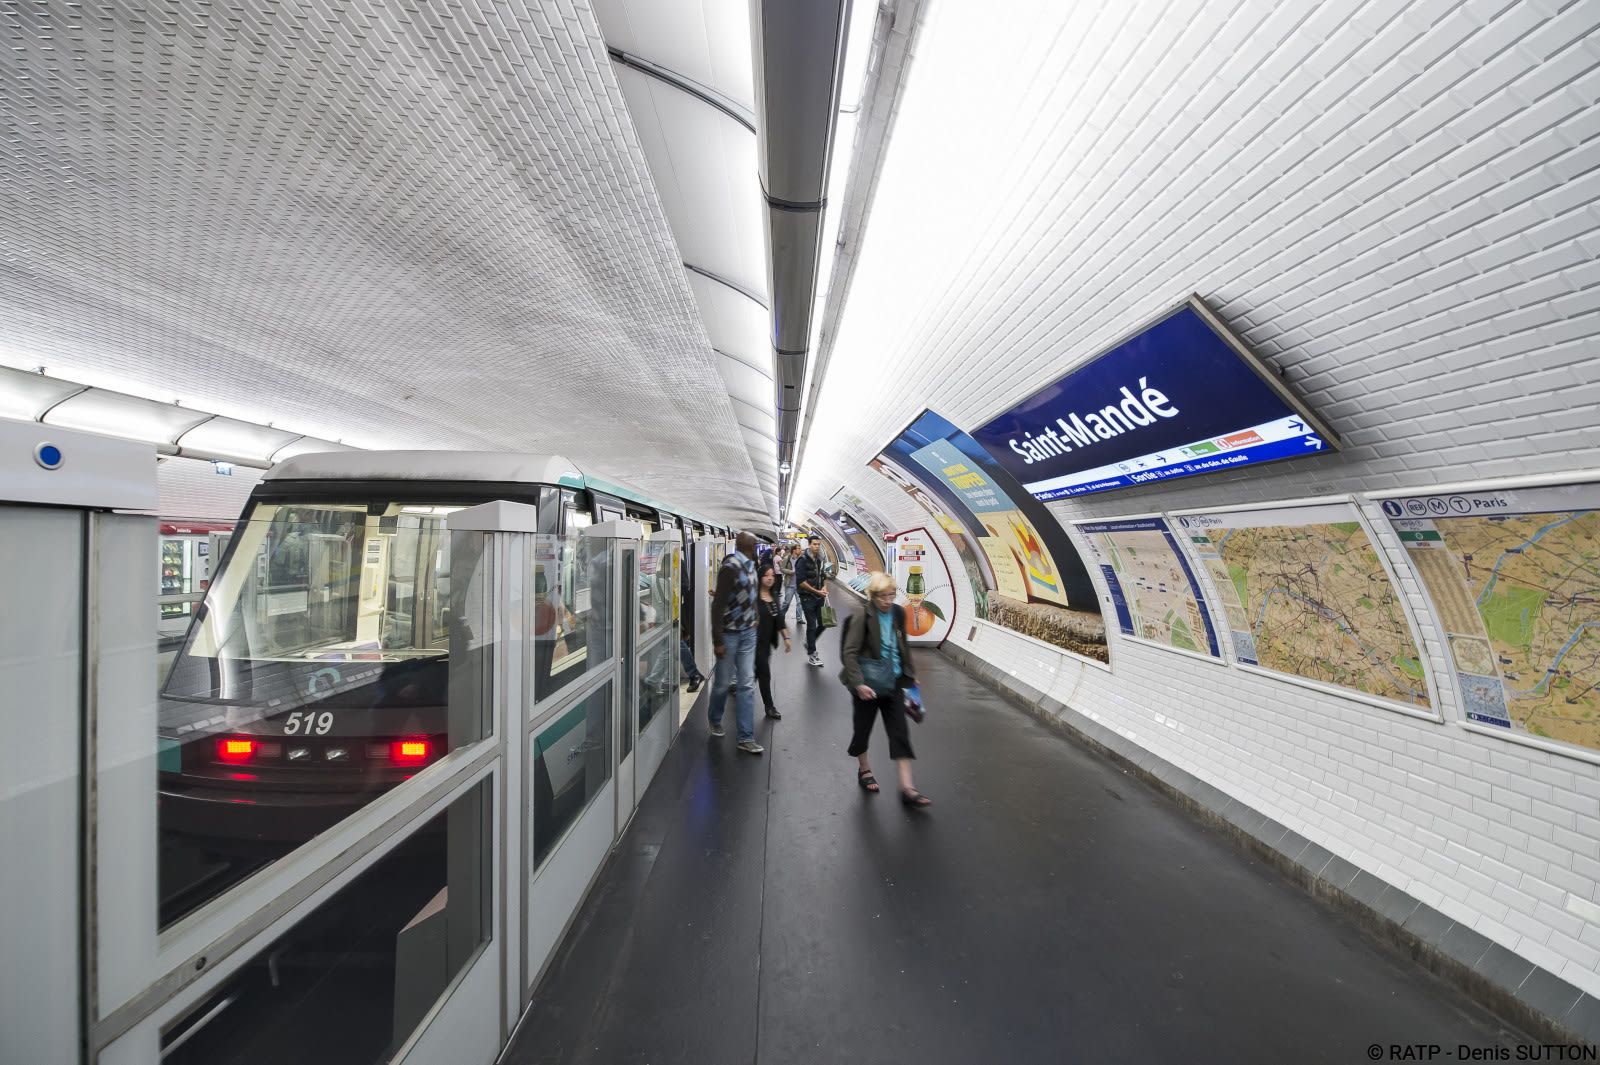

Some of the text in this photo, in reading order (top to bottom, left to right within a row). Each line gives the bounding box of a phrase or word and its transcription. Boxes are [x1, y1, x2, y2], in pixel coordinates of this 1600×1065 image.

[1008, 376, 1180, 464] Saint-Mandé
[1131, 471, 1158, 483] Sortie
[1409, 497, 1508, 511] RER M T Paris
[284, 711, 334, 735] 519
